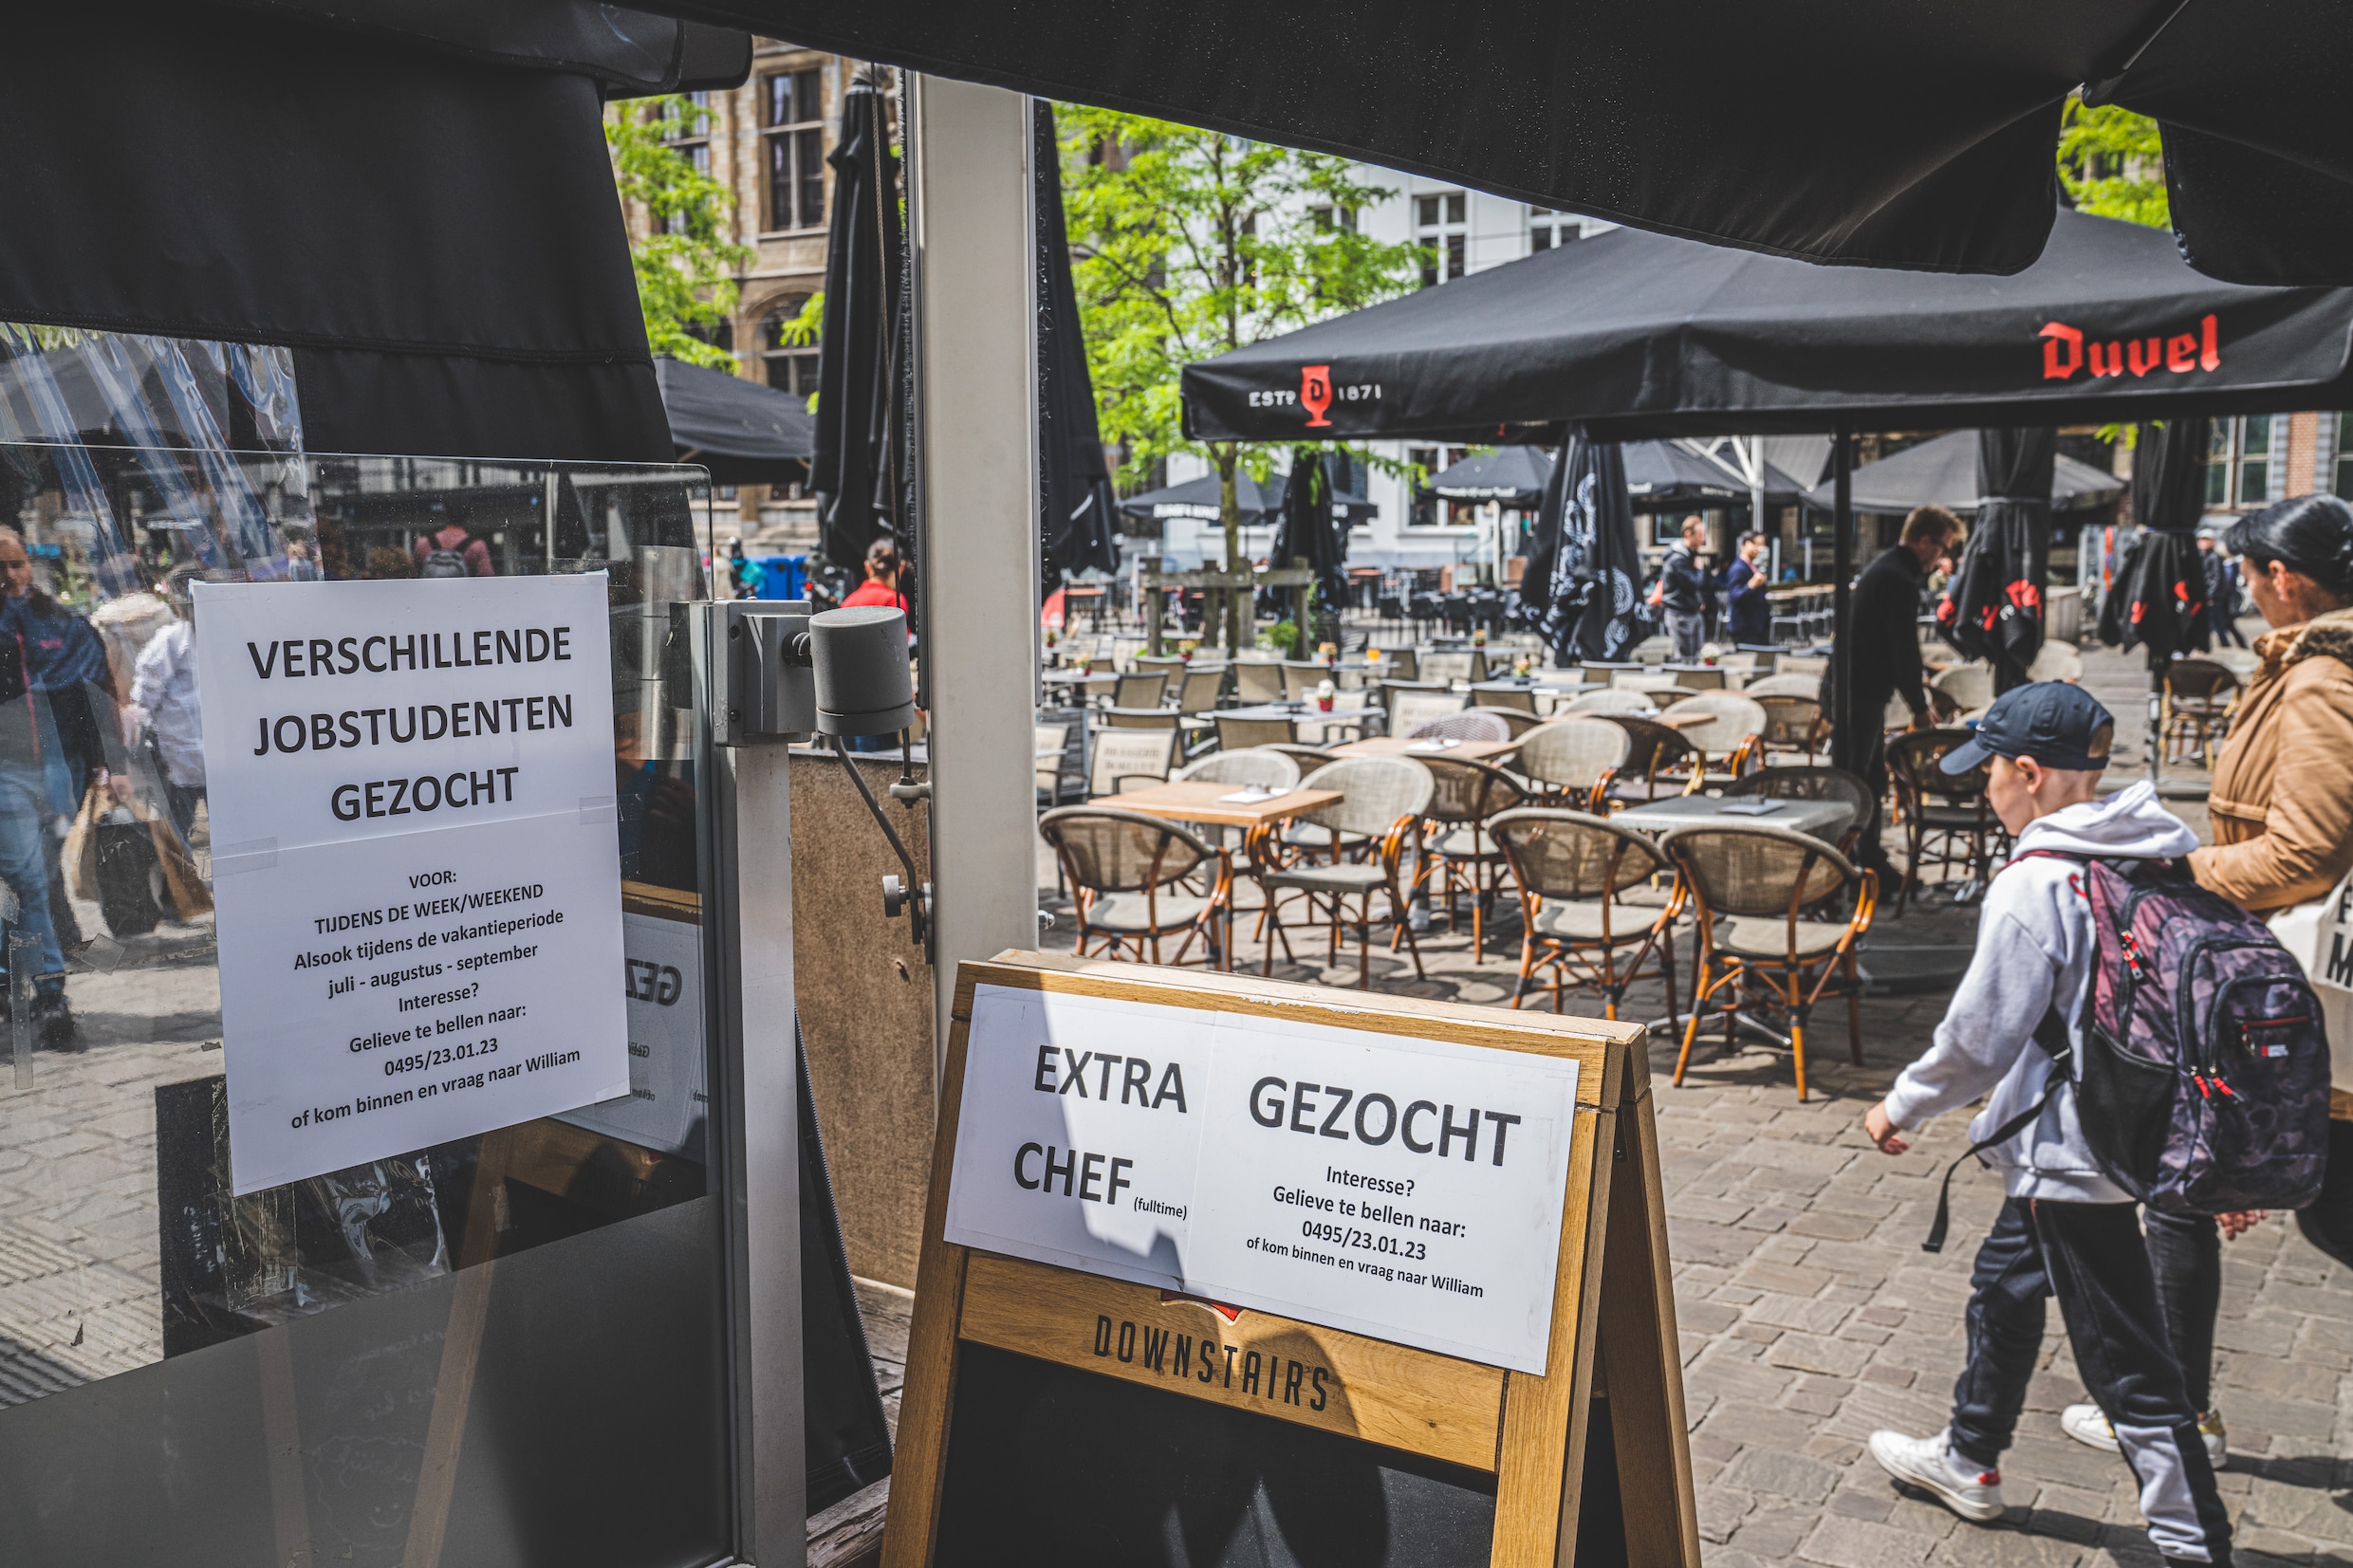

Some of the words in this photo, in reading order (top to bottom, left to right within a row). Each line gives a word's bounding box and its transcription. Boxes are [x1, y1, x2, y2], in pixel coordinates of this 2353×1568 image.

[2038, 313, 2221, 379] Duvel
[1338, 383, 1382, 401] 1871
[247, 627, 571, 679] VERSCHILLENDE
[254, 694, 572, 756] JOBSTUDENTEN
[331, 766, 518, 821] GEZOCHT
[409, 871, 456, 889] VOOR:
[314, 910, 382, 934] TIJDENS
[388, 905, 409, 922] DE
[414, 884, 543, 917] WEEK/WEEKEND
[294, 946, 352, 969] Alsook
[357, 939, 413, 960] tijdens
[417, 932, 436, 948] de
[441, 910, 563, 943] vakantieperiode
[328, 976, 354, 999] juli
[371, 964, 442, 987] augustus
[457, 946, 538, 970] september
[399, 983, 478, 1012] Interesse?
[350, 1030, 411, 1052] Gelieve
[416, 1026, 431, 1039] te
[436, 1015, 483, 1034] bellen
[489, 1006, 526, 1024] naar:
[385, 1038, 497, 1076] 0495/23.01.23
[1034, 1043, 1188, 1114] EXTRA
[291, 1110, 309, 1128] of
[314, 1105, 351, 1123] kom
[357, 1091, 413, 1114] binnen
[418, 1085, 437, 1098] en
[442, 1073, 484, 1093] vraag
[489, 1064, 521, 1081] naar
[526, 1051, 580, 1072] William
[1250, 1077, 1521, 1166] GEZOCHT
[1014, 1141, 1134, 1206] CHEF
[1327, 1166, 1415, 1196] Interesse?
[1135, 1197, 1187, 1221] (fulltime)
[1274, 1186, 1333, 1211] Gelieve
[1339, 1199, 1355, 1216] te
[1362, 1201, 1414, 1227] bellen
[1419, 1217, 1465, 1237] naar:
[1303, 1221, 1425, 1260] 0495/23.01.23
[1247, 1237, 1260, 1249] of
[1263, 1239, 1288, 1256] kom
[1292, 1245, 1334, 1265] binnen
[1339, 1259, 1353, 1270] en
[1359, 1263, 1394, 1282] vraag
[1398, 1271, 1427, 1285] naar
[1432, 1275, 1483, 1298] William
[1094, 1315, 1328, 1411] DOWNSTAIRS
